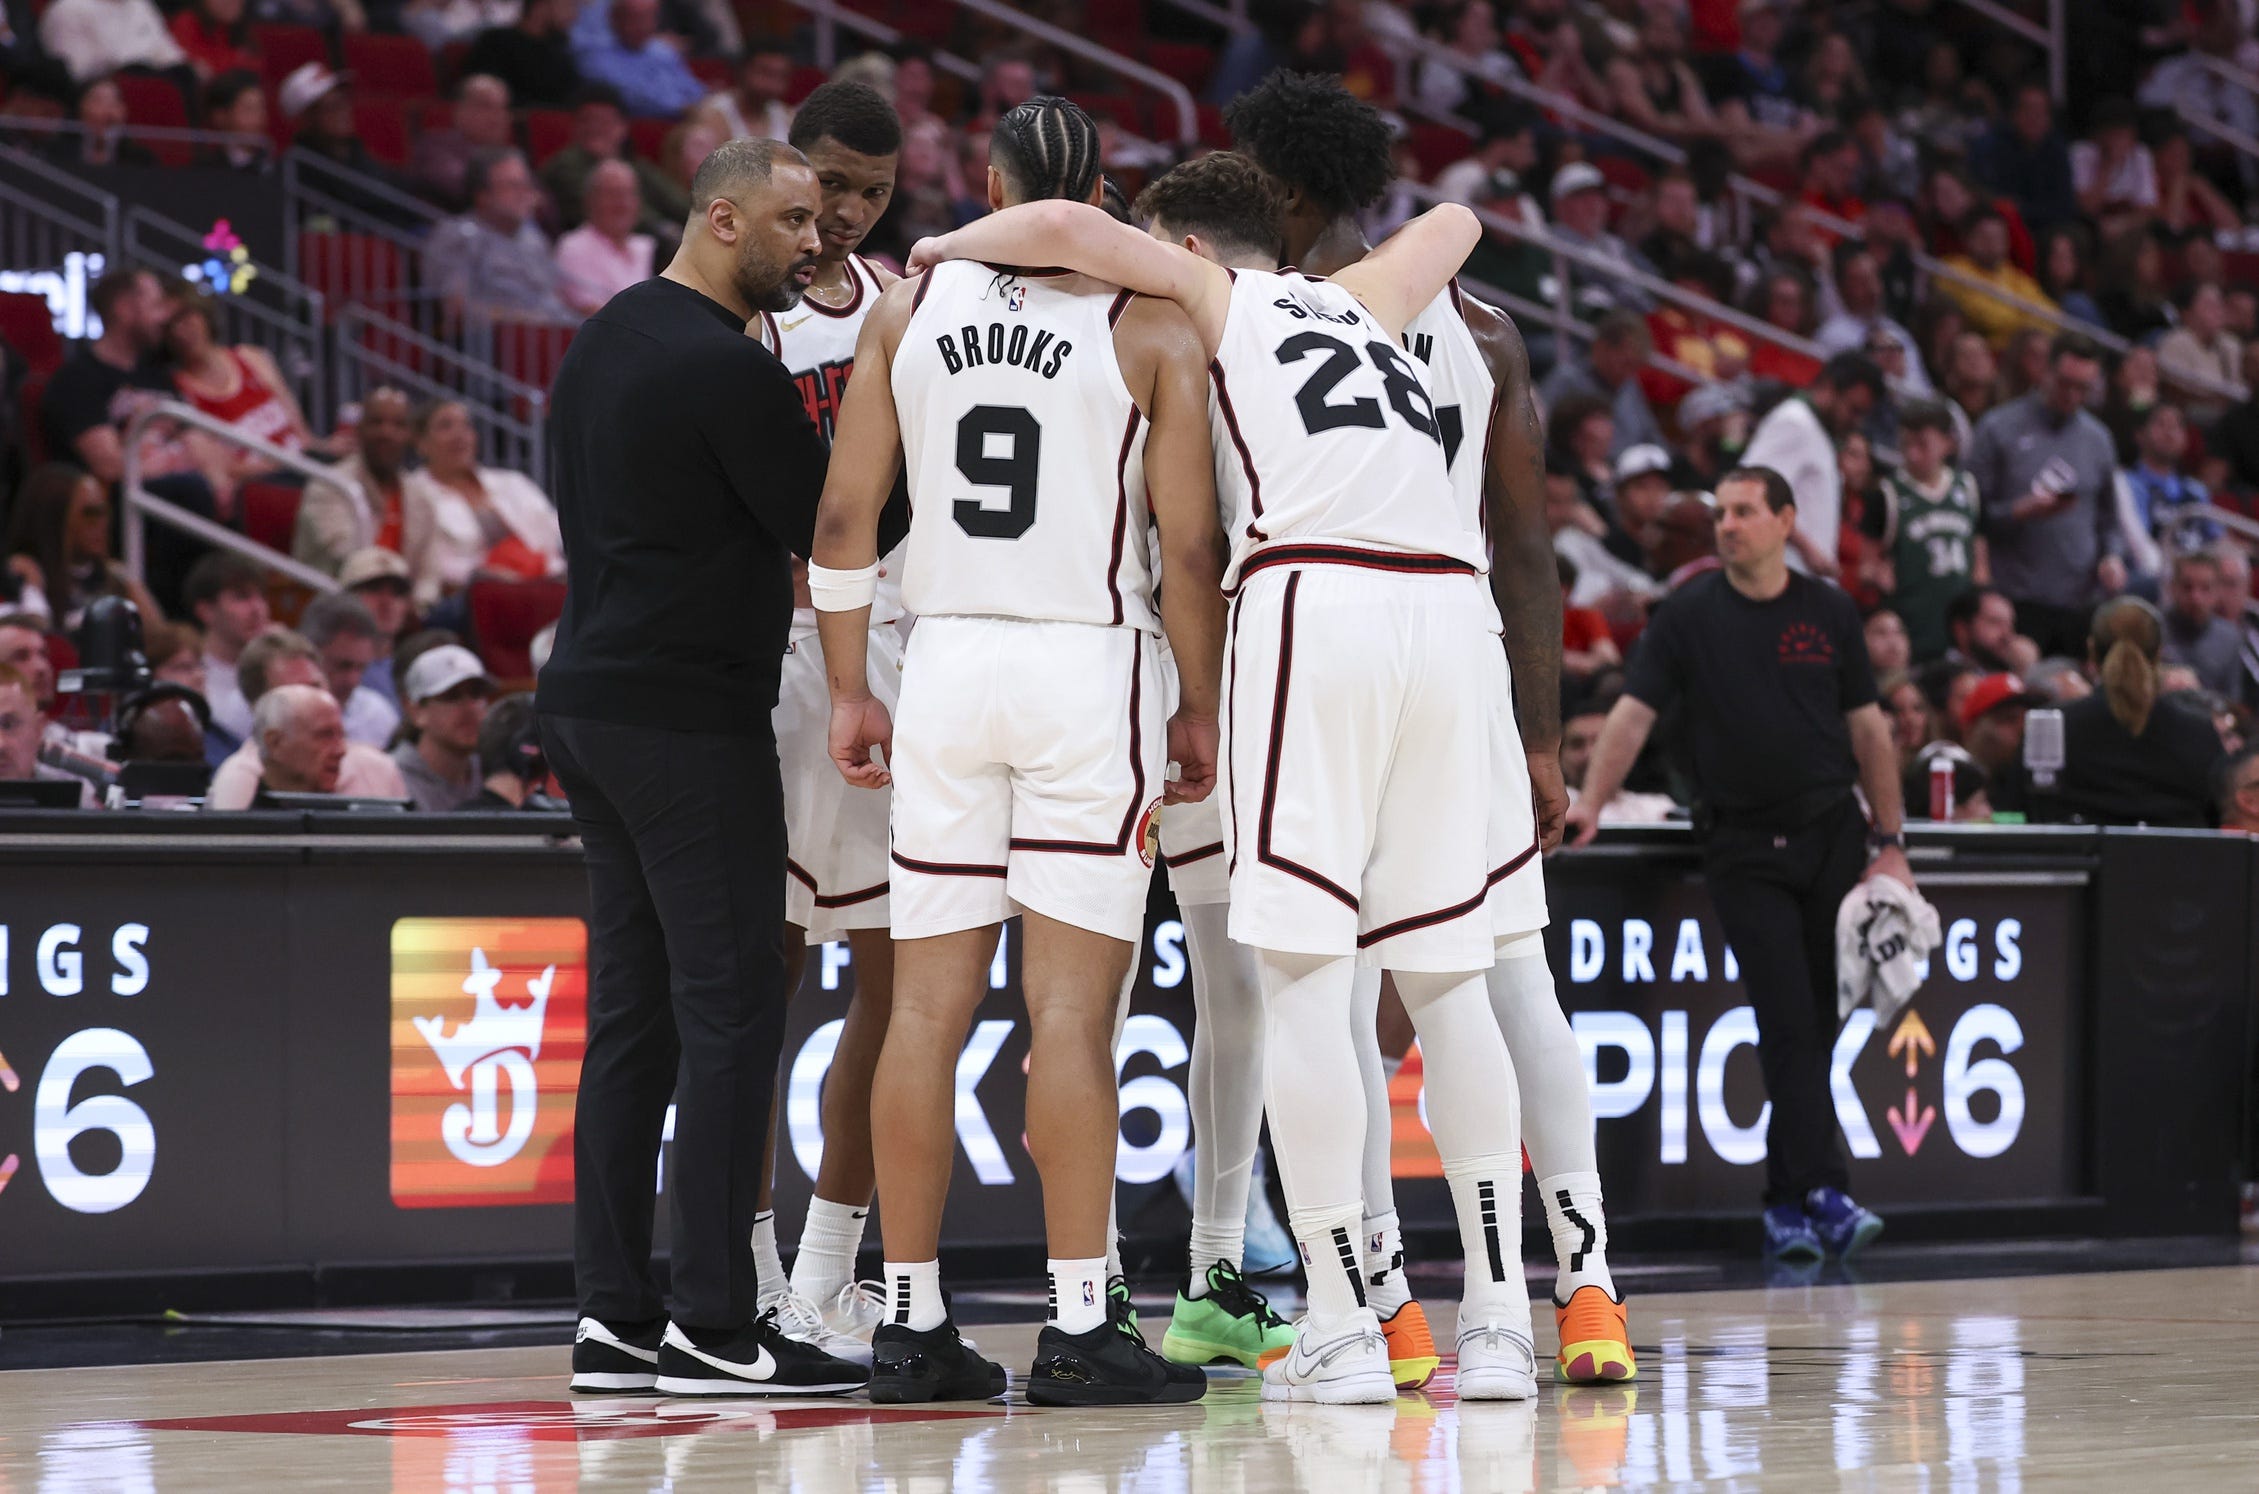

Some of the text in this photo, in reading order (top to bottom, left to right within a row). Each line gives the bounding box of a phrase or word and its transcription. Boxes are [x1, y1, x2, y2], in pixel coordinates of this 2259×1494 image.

[936, 322, 1072, 380] BROOKS
[1273, 330, 1441, 447] 28
[951, 403, 1042, 541] 9
[0, 923, 150, 996] GS
[34, 1027, 156, 1213] 6
[1114, 1014, 1190, 1184] 6
[1943, 1004, 2025, 1158] 6
